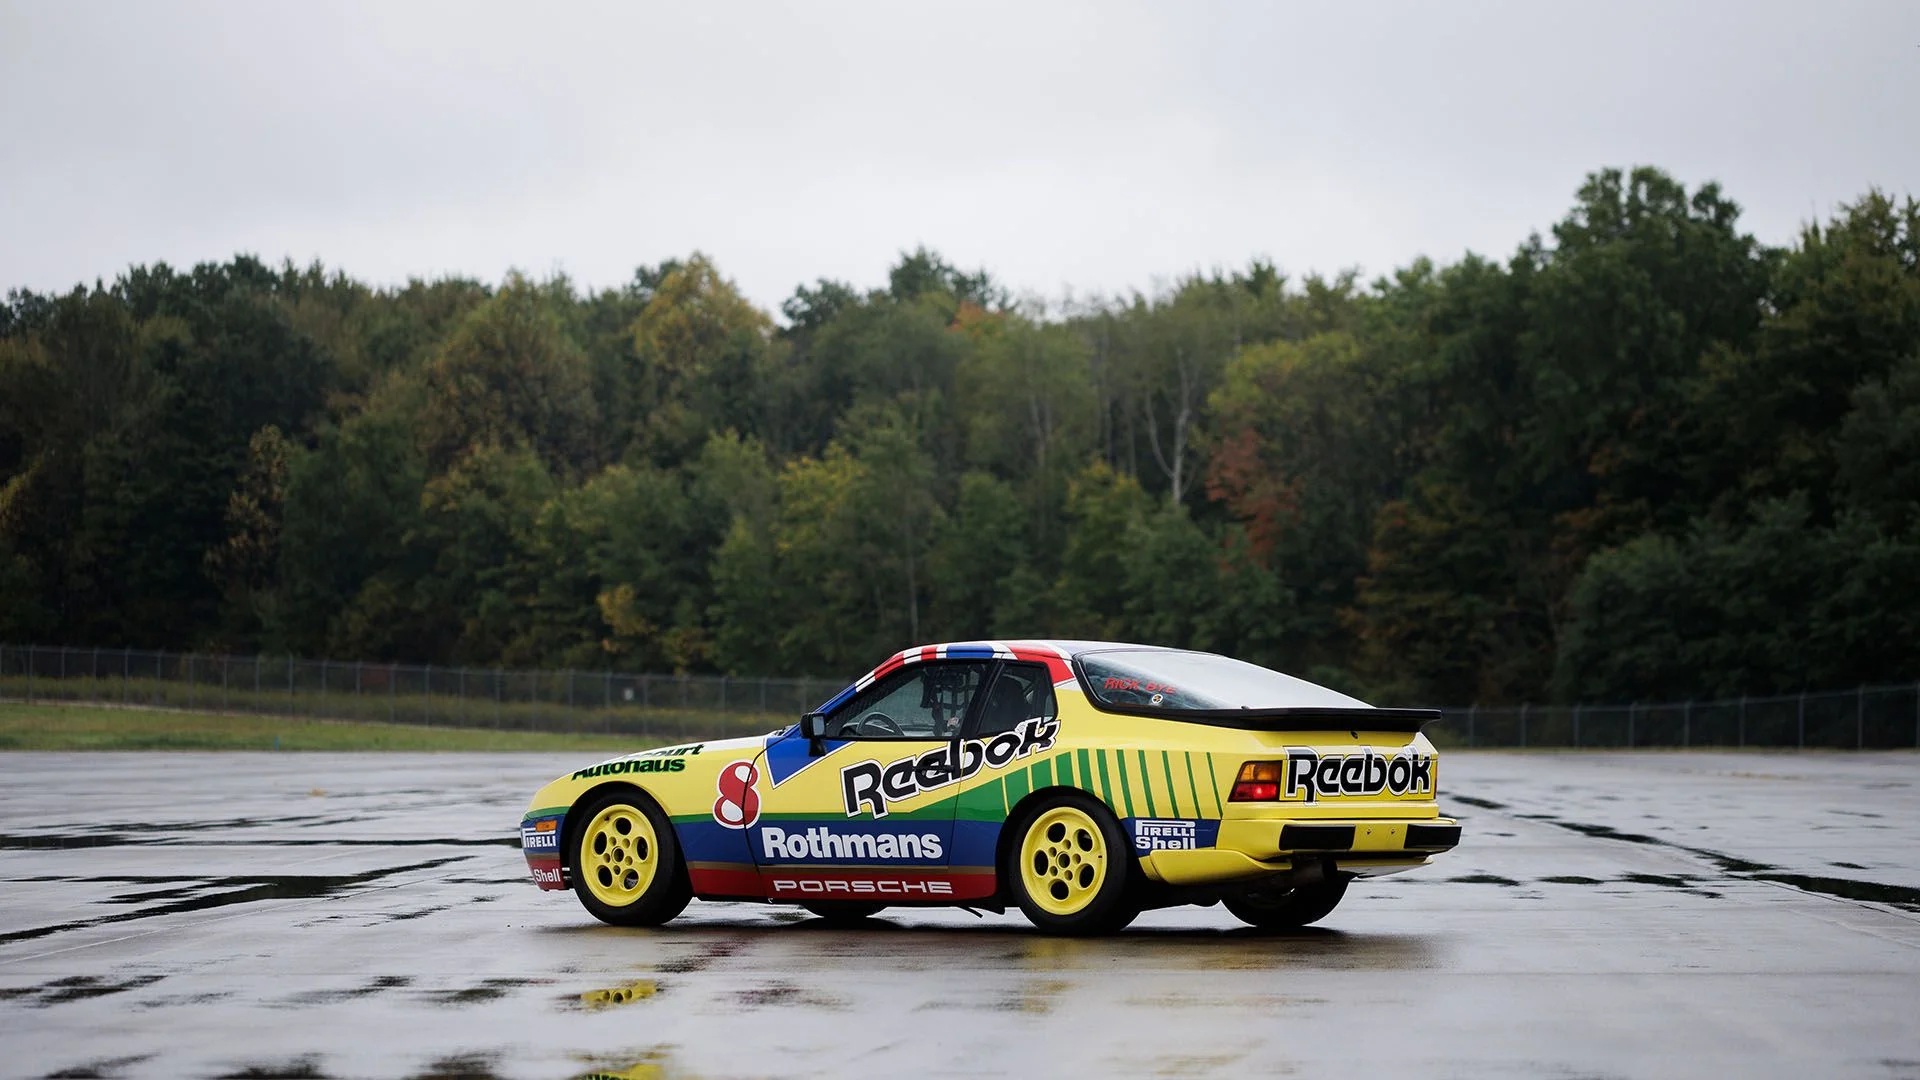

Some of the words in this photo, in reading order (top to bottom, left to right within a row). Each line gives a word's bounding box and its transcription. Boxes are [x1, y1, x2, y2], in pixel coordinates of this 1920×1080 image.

[1104, 677, 1142, 691] RICK
[841, 717, 1061, 819] Reebok
[1283, 745, 1432, 806] Reebok
[713, 760, 761, 829] 8
[1135, 820, 1196, 836] PIRELLI
[522, 828, 557, 848] PIRELLI
[761, 827, 943, 859] Rothmans
[1135, 836, 1196, 849] Shell
[533, 868, 561, 882] Shell
[773, 880, 953, 894] PORSCHE
